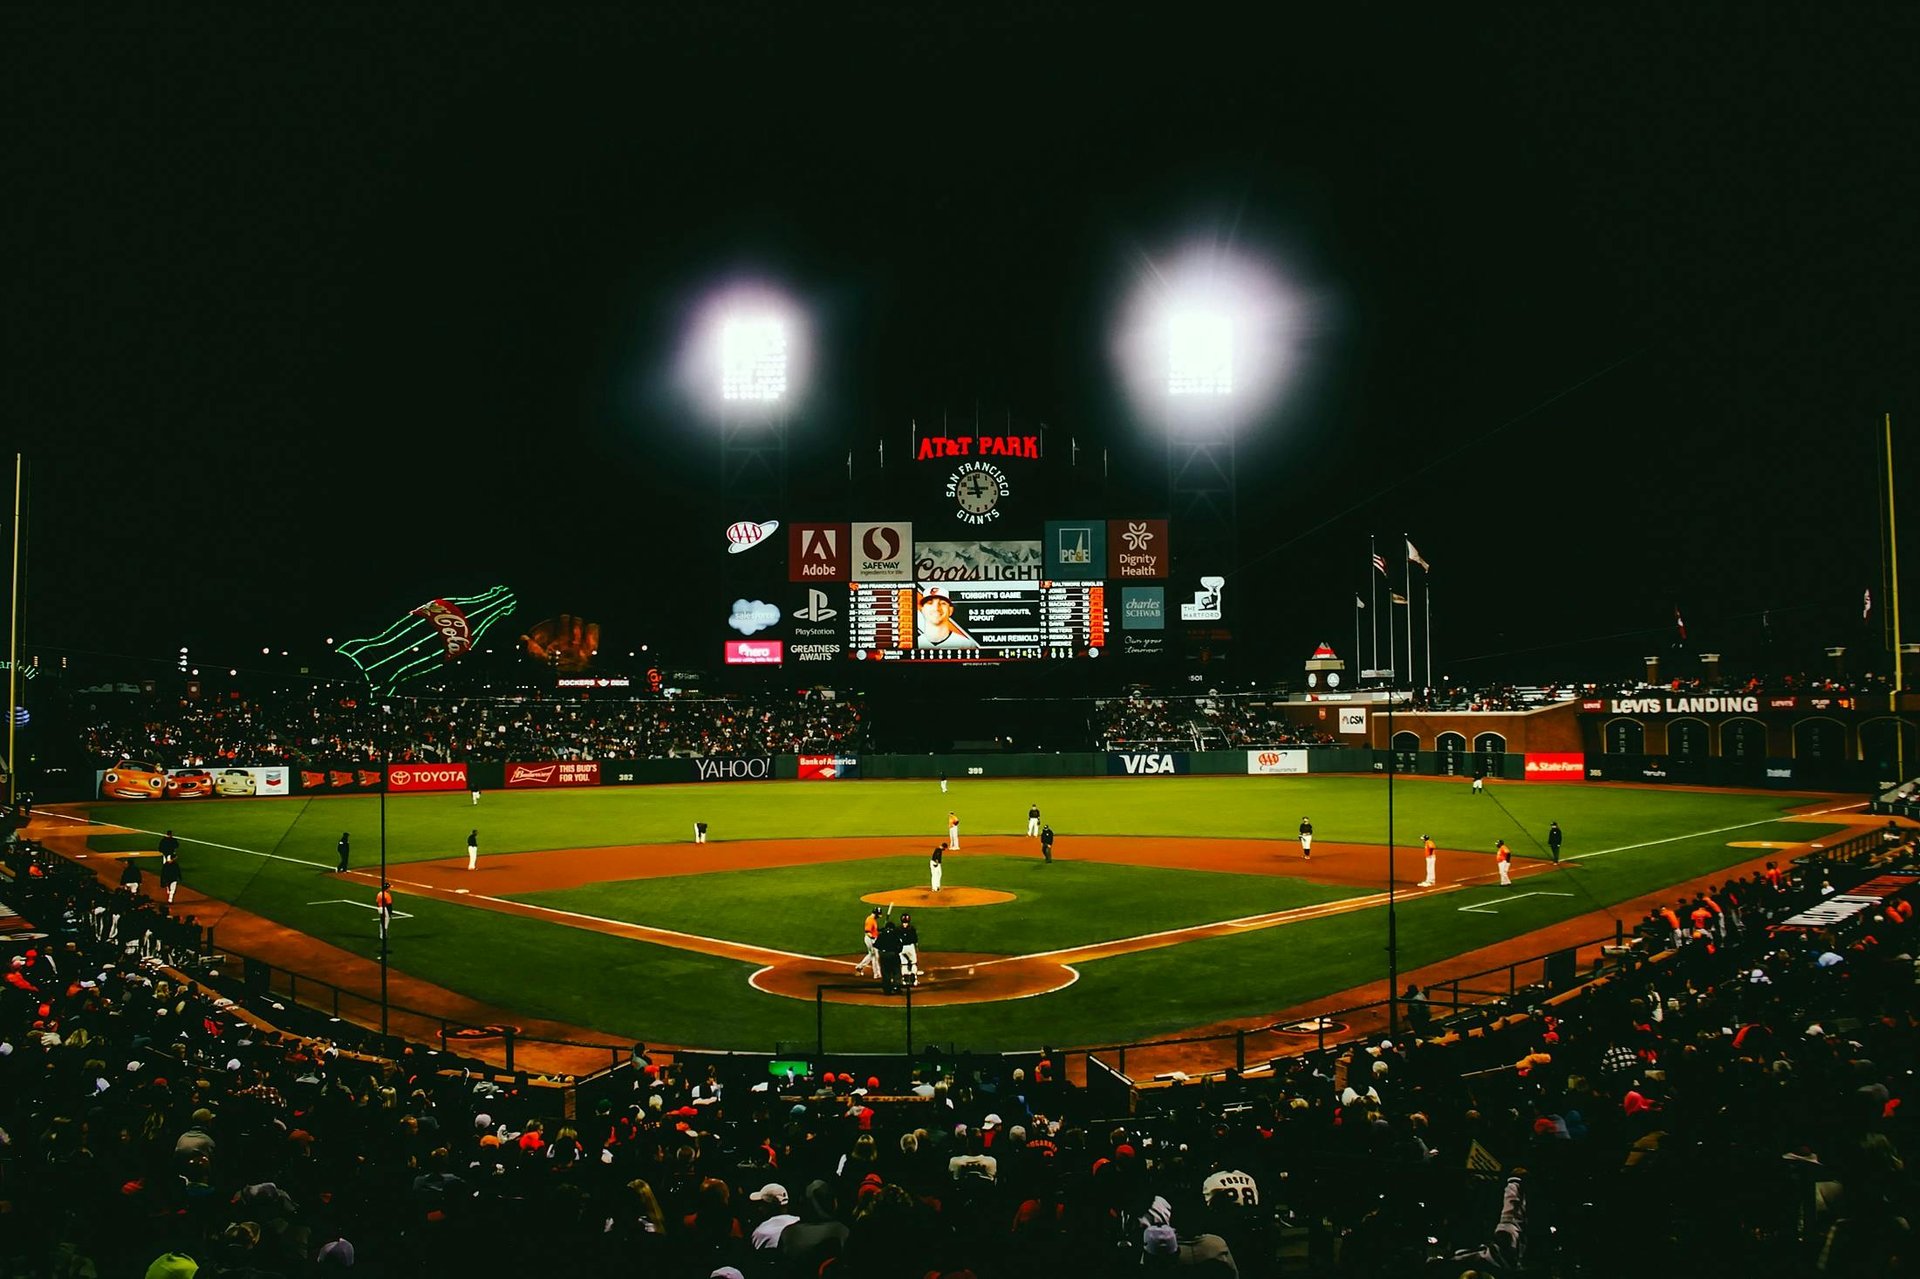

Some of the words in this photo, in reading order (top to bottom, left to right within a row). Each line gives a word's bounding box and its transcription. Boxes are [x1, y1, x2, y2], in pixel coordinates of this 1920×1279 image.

[918, 437, 972, 460] AT&T
[979, 437, 1038, 459] PARK
[946, 473, 960, 498] SAN
[958, 461, 1010, 498] FRANCISCO
[957, 508, 1000, 526] GIANTS
[730, 522, 761, 544] AAA
[1061, 549, 1089, 562] PG&E
[1120, 554, 1157, 566] Dignity
[802, 564, 836, 575] Adobe
[914, 558, 983, 580] Coors
[984, 565, 1043, 580] LIGHT
[1121, 566, 1156, 576] Health
[1126, 598, 1160, 609] charles
[1126, 609, 1161, 617] SCHWAB
[434, 614, 470, 655] Cola
[795, 628, 835, 637] PlayStation
[790, 644, 841, 653] GREATNESS
[799, 653, 832, 661] AWAITS
[1665, 697, 1758, 712] LANDING
[1349, 716, 1364, 724] CSN
[800, 757, 818, 765] Bank
[818, 757, 826, 765] of
[827, 757, 857, 765] America
[1118, 754, 1175, 774] VISA
[1259, 753, 1279, 766] AAA
[559, 764, 575, 773] THIS
[576, 764, 597, 773] BUD'S
[696, 758, 771, 780] YAHOO!
[412, 771, 466, 783] TOYOTA
[559, 773, 573, 782] FOR
[574, 773, 590, 782] YOU.
[1220, 1176, 1249, 1187] POSEY
